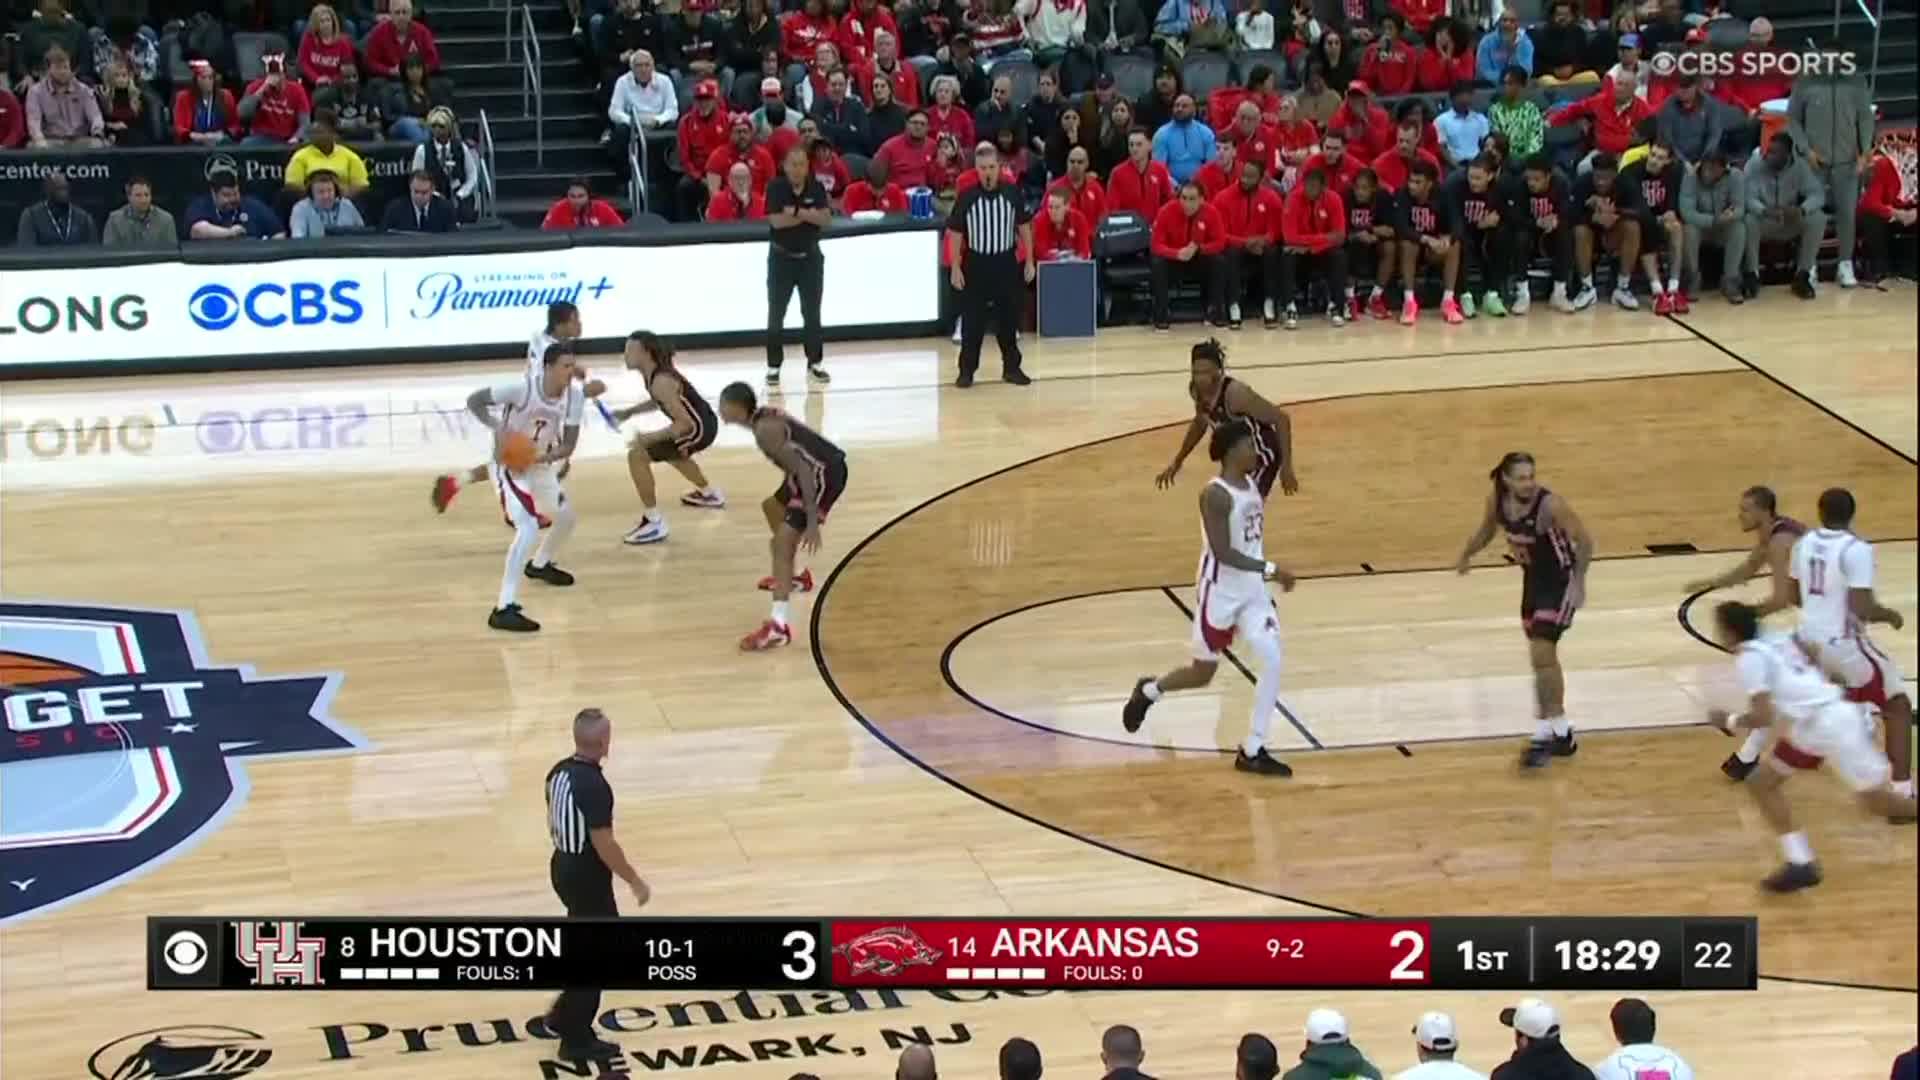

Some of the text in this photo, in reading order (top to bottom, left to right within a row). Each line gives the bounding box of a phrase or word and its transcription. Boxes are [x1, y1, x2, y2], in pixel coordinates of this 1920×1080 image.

[244, 280, 363, 327] CBS
[4, 681, 203, 731] GET
[880, 1023, 972, 1049] NJ
